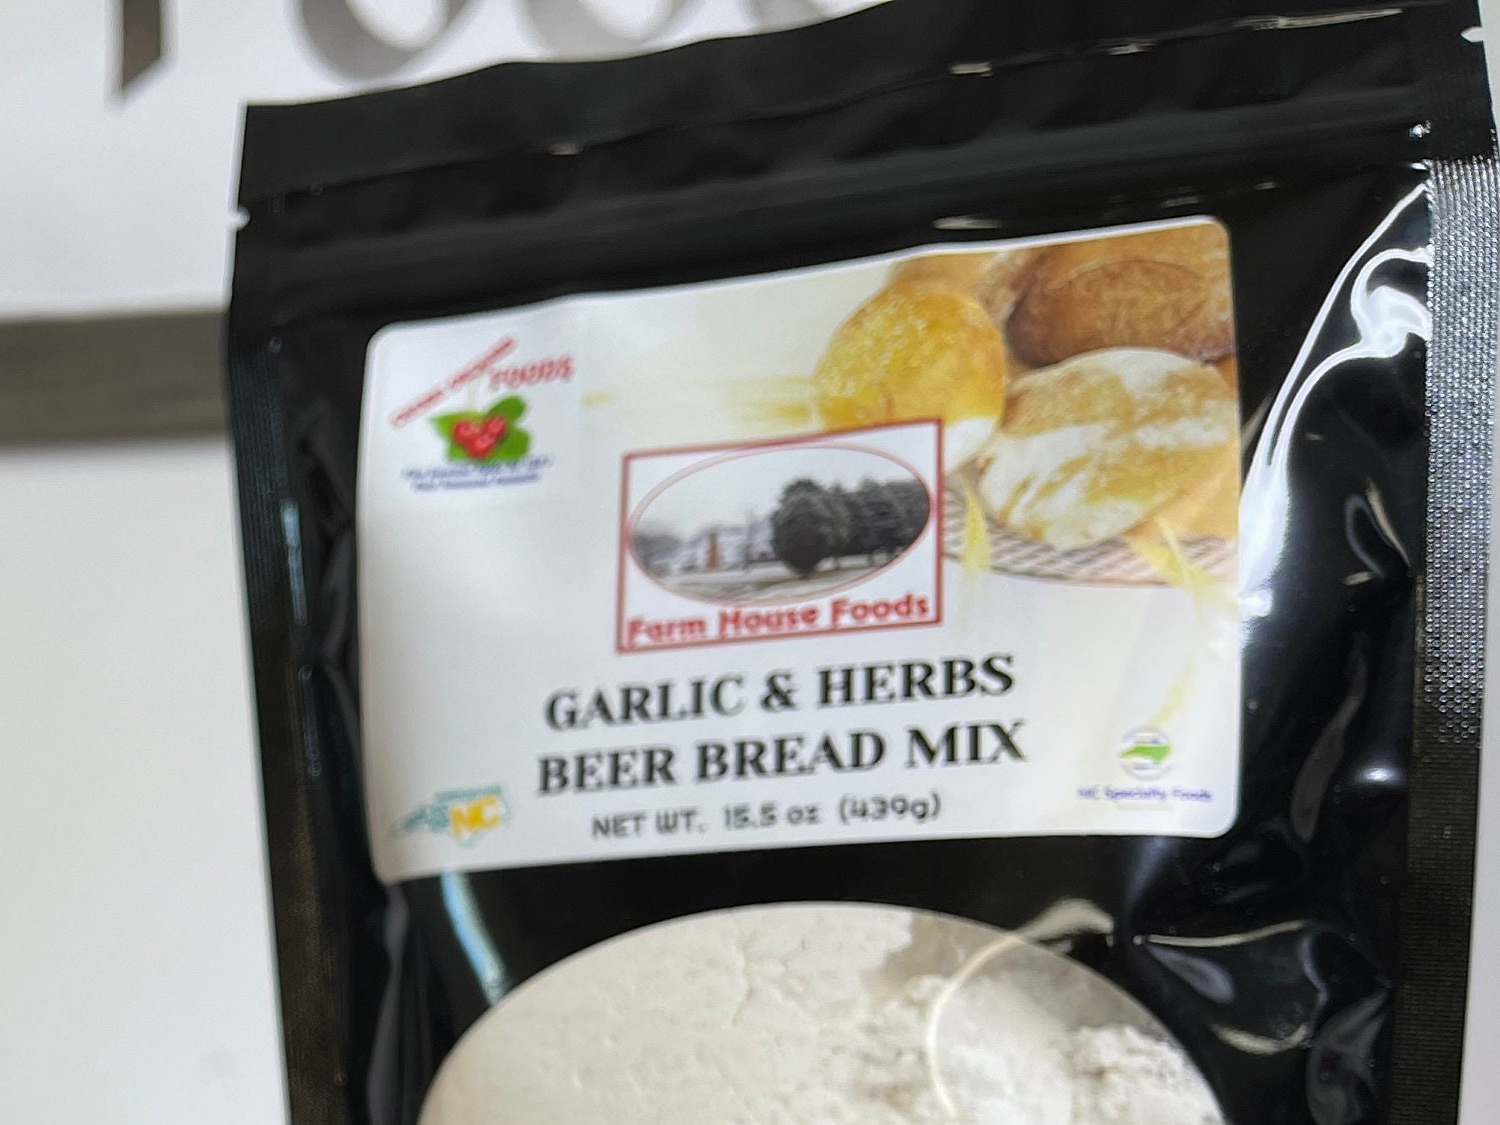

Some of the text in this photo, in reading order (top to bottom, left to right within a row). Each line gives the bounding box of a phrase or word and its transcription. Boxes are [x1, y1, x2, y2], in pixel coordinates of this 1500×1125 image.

[626, 592, 931, 646] Farm House Foods
[545, 655, 1017, 731] GARLIC & HERBS
[537, 720, 1029, 797] BEER BREAD MIX
[591, 791, 943, 841] NET WT. 15.5 oz (439g)
